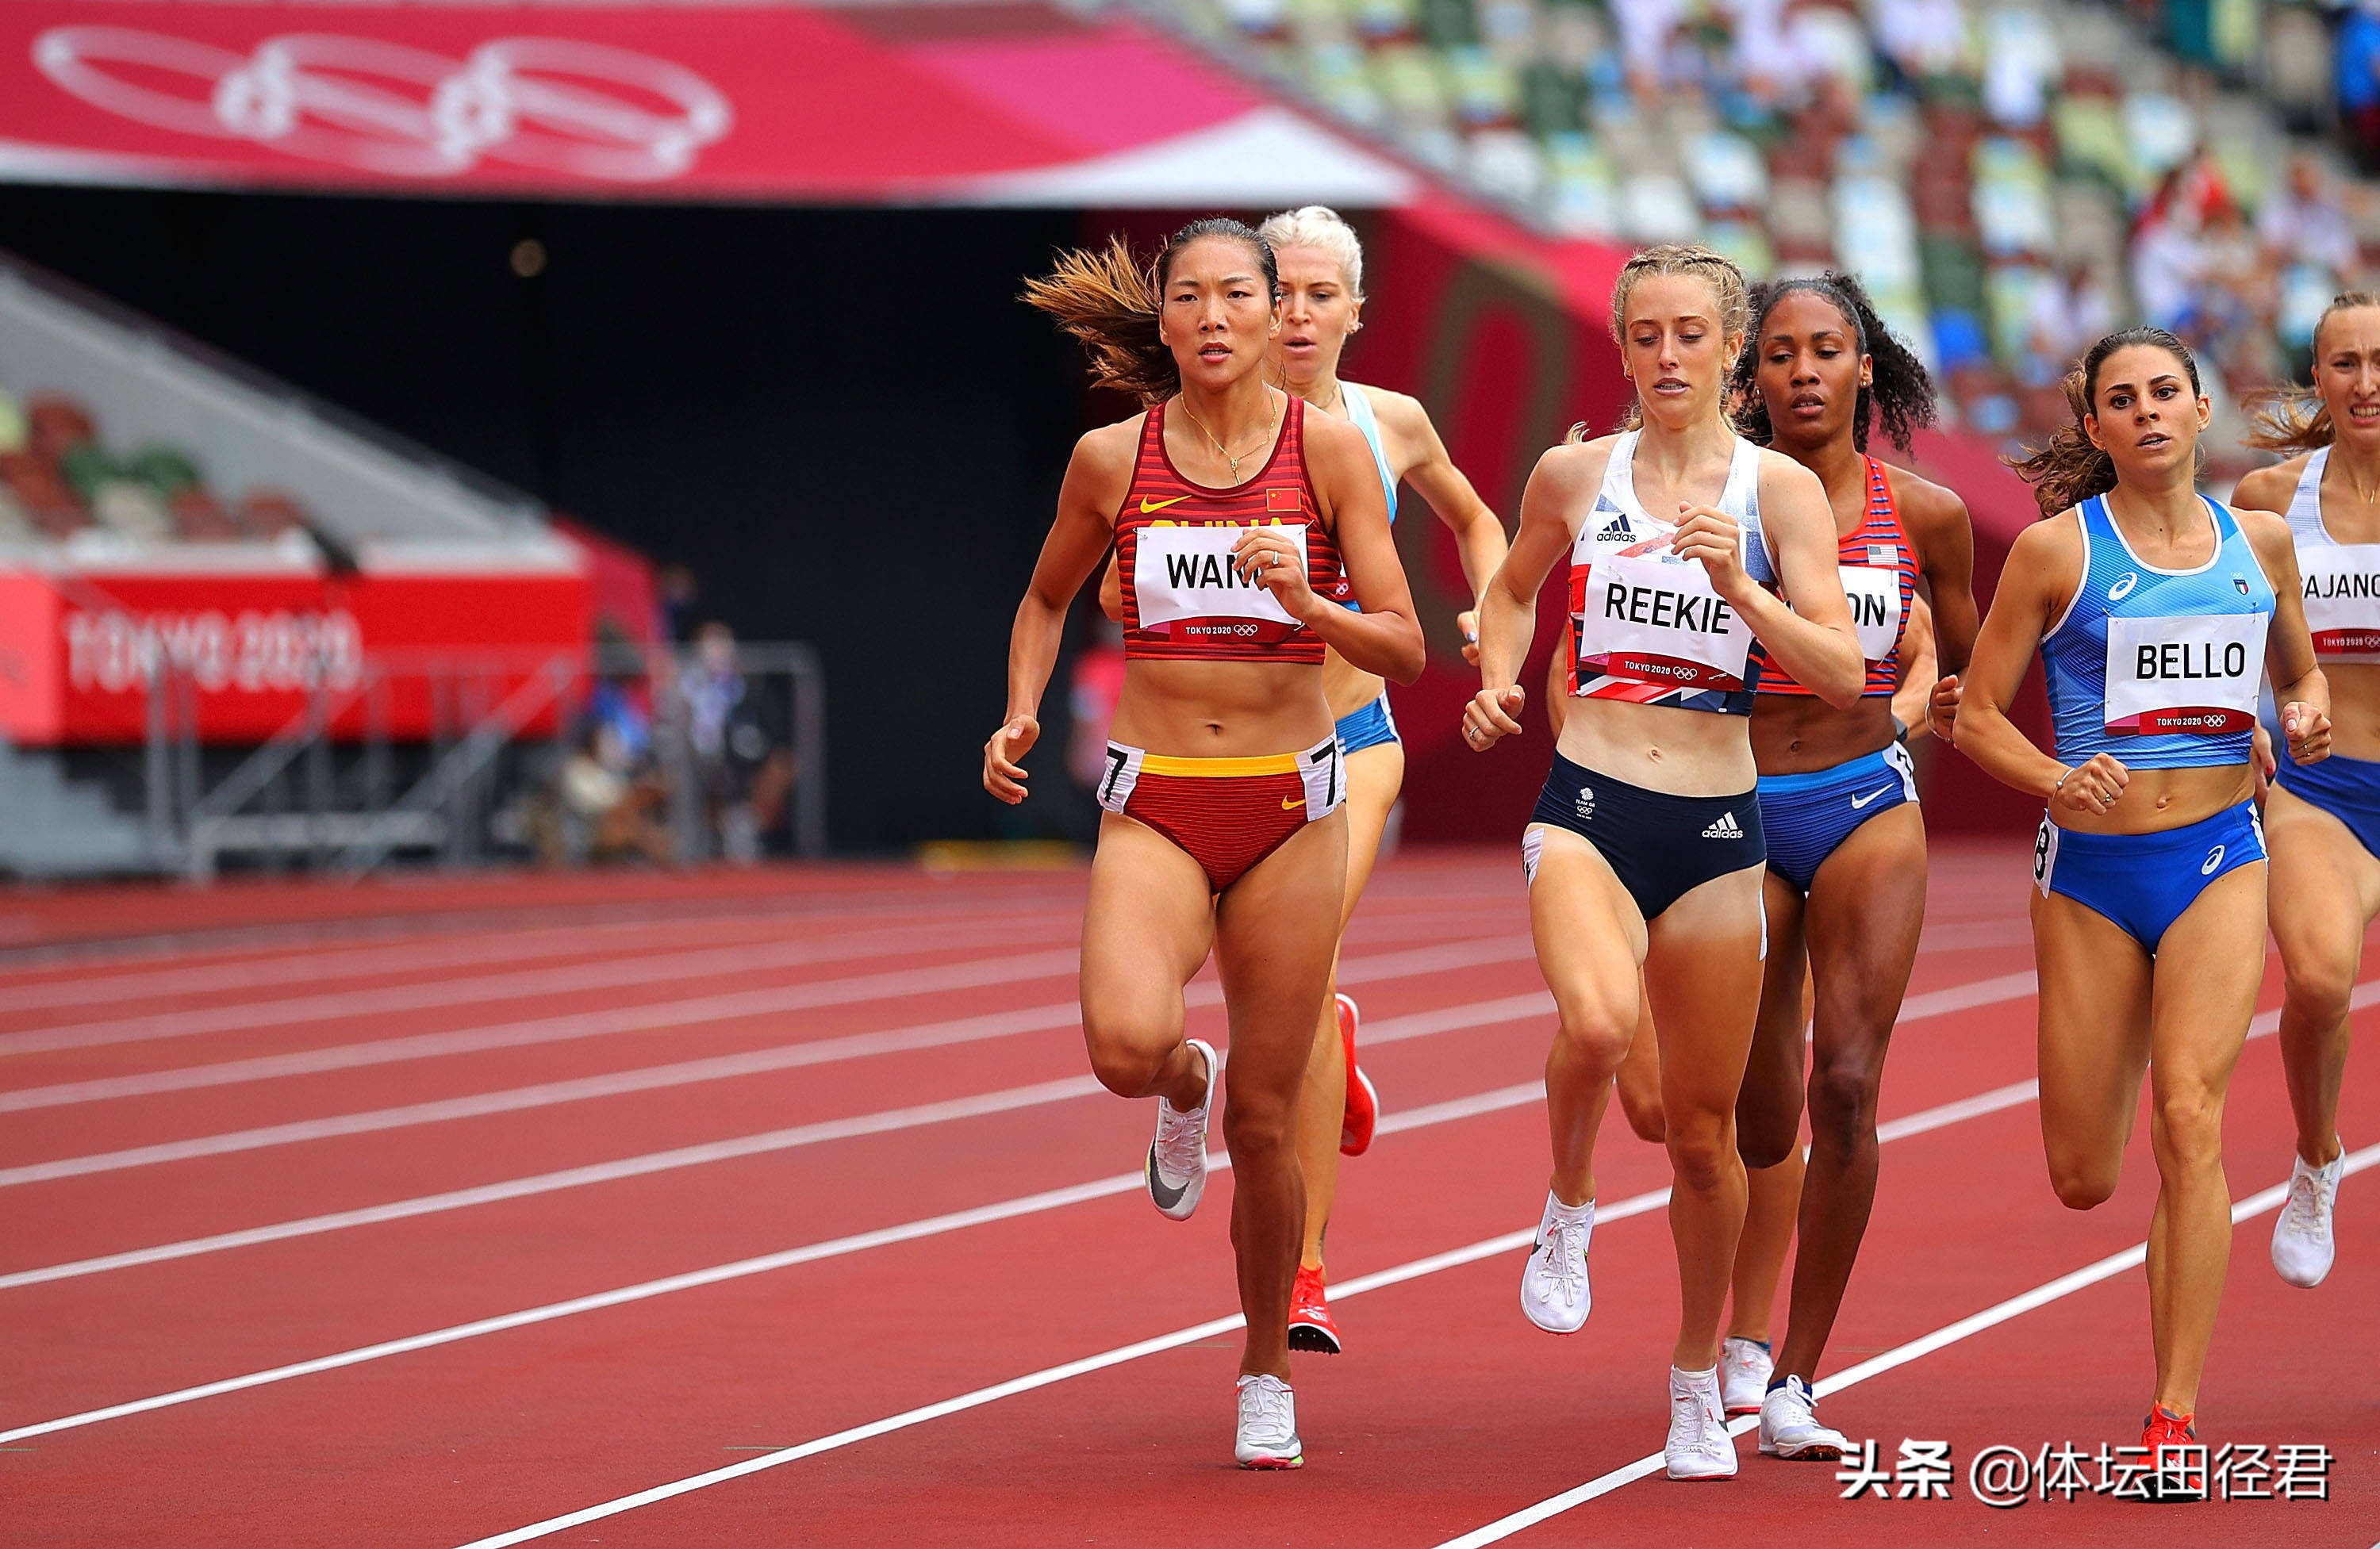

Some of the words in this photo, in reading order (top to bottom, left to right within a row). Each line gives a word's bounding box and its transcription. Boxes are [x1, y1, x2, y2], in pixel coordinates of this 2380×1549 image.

[1596, 531, 1637, 543] adidas
[1166, 554, 1269, 589] WAN
[1605, 582, 1732, 635] REEKIE
[2322, 637, 2345, 646] TOKYO
[1624, 661, 1650, 672] TOKYO
[1651, 665, 1671, 675] 2020
[2136, 642, 2245, 681] BELLO
[2156, 718, 2182, 727] TOKYO
[2182, 717, 2202, 726] 2020
[1106, 746, 1129, 801] 7
[1310, 741, 1336, 807] 7
[1702, 828, 1744, 839] adidas
[2035, 823, 2050, 880] 8
